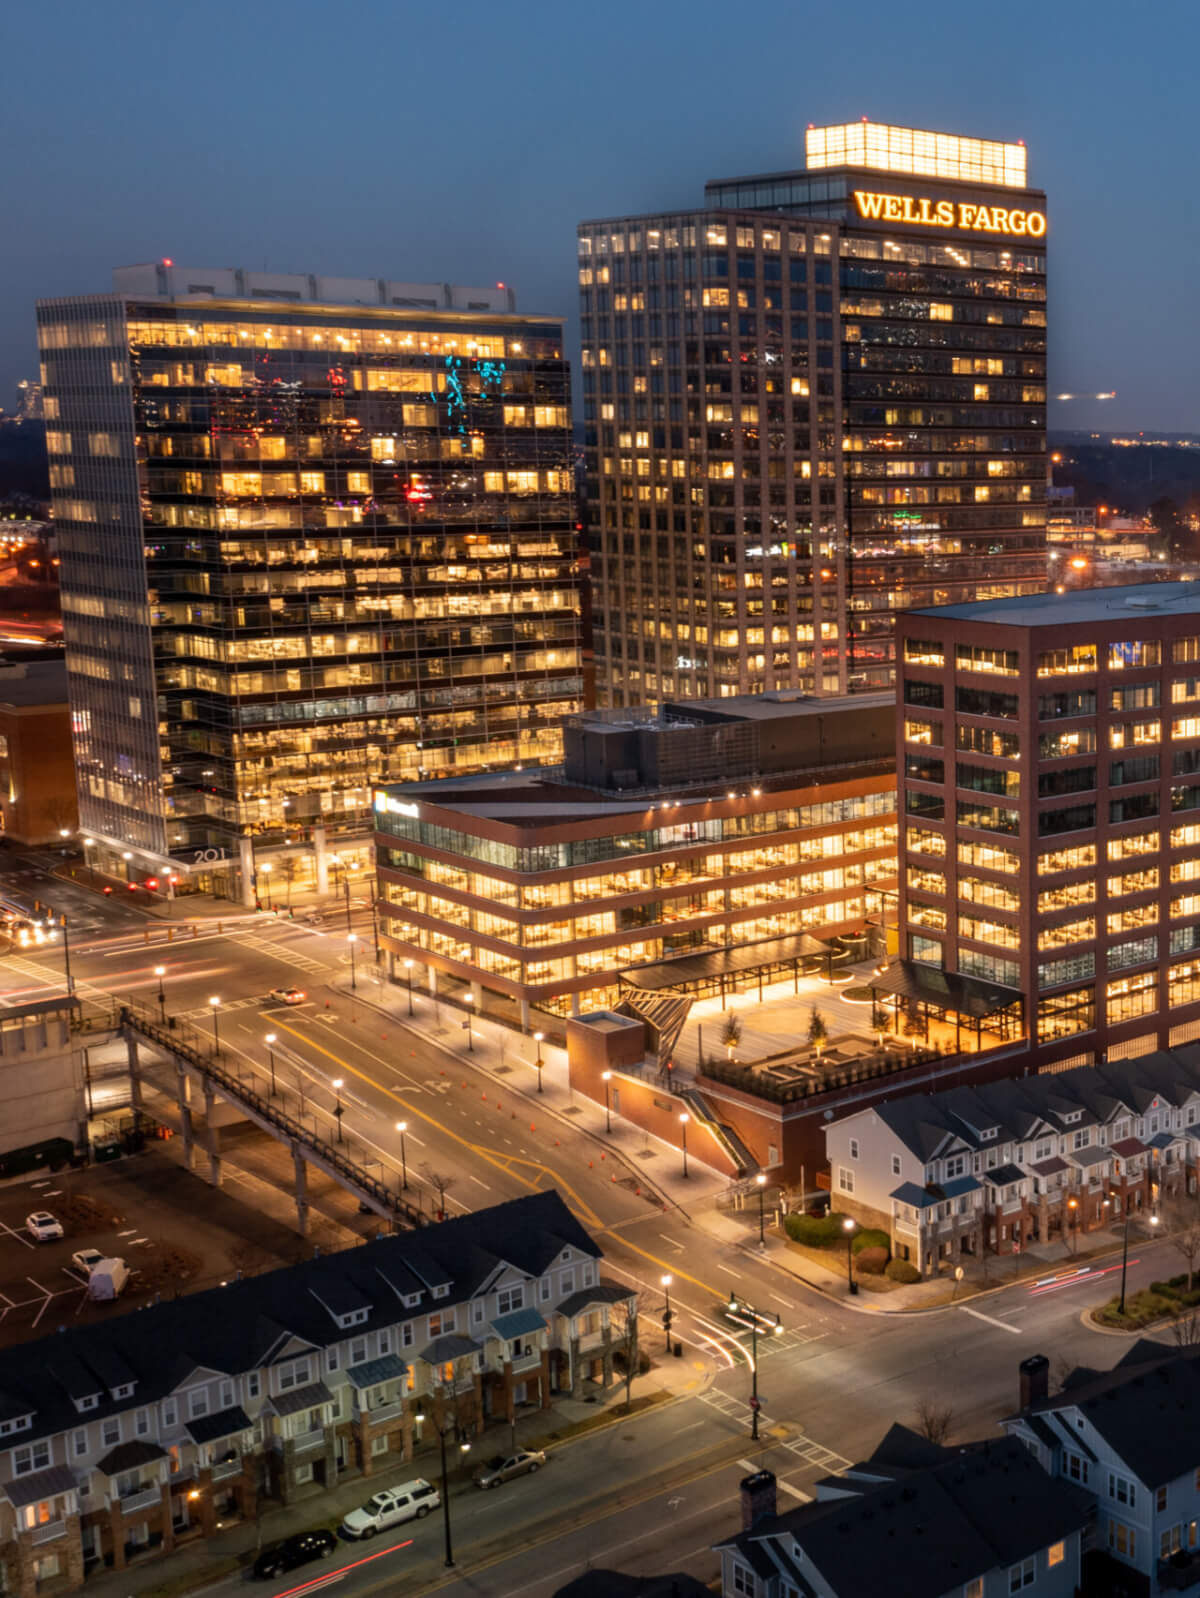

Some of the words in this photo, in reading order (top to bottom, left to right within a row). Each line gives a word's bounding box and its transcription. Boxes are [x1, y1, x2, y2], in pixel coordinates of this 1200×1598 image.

[853, 190, 954, 227] WELLS
[958, 203, 1047, 237] FARGO
[194, 848, 225, 864] 201
